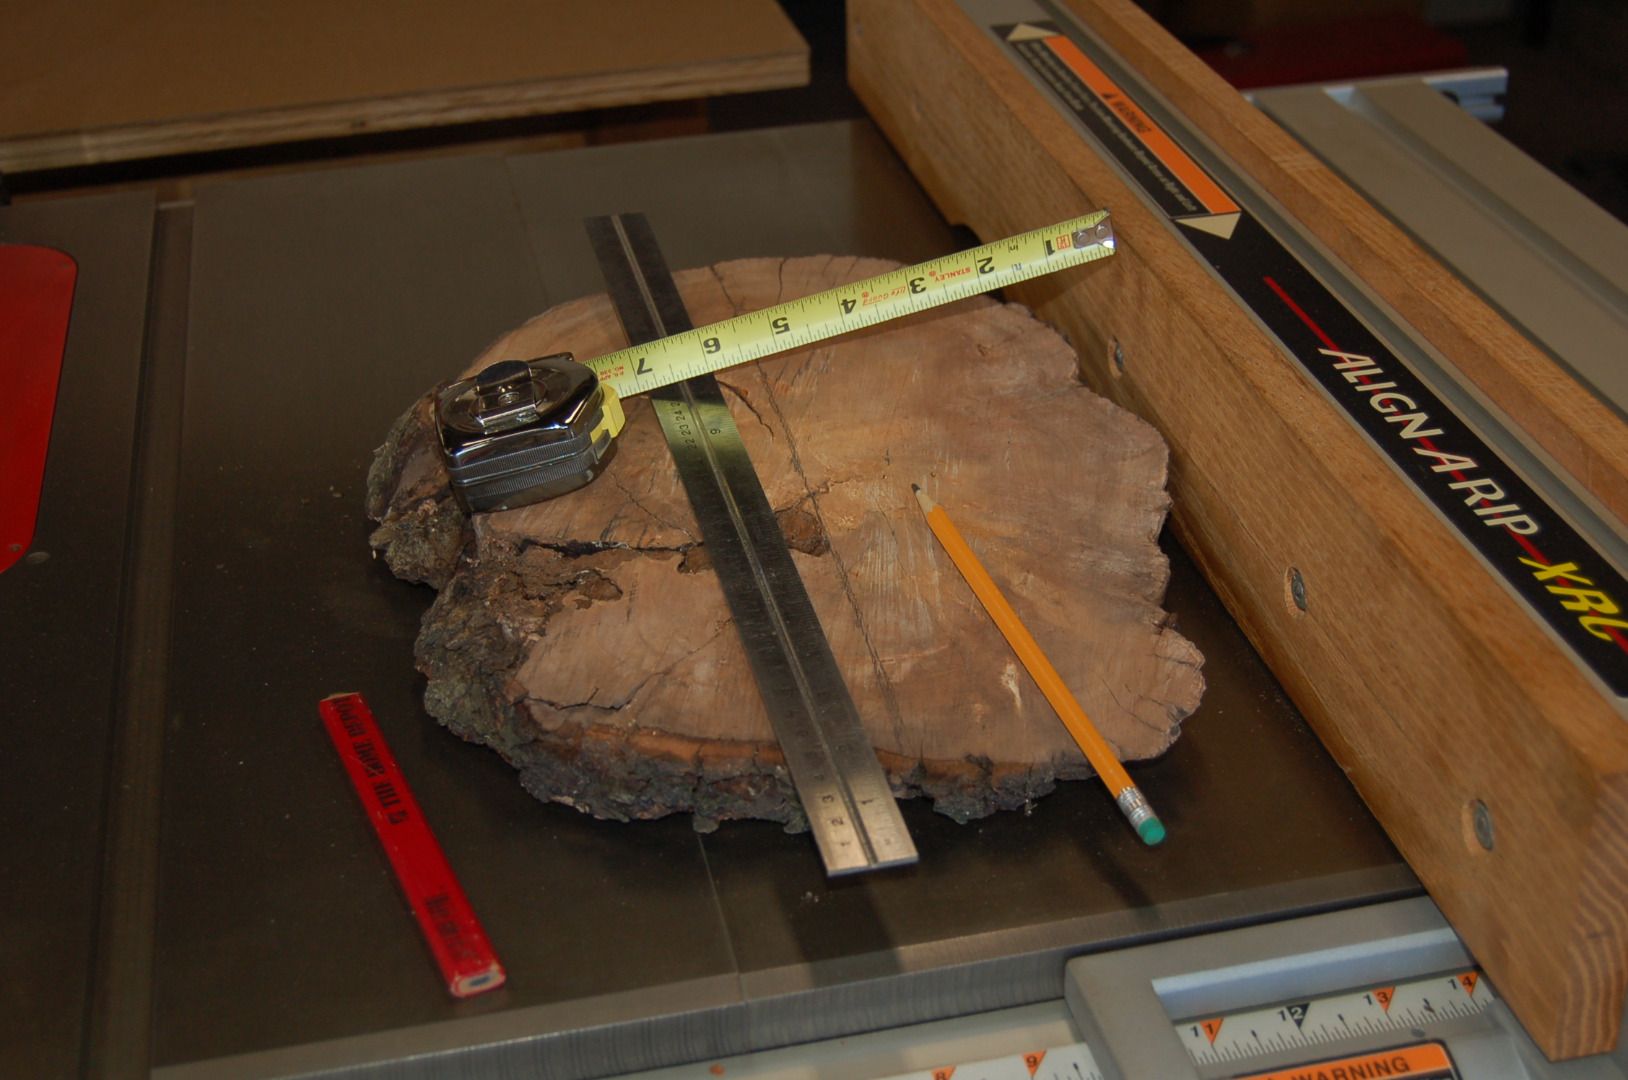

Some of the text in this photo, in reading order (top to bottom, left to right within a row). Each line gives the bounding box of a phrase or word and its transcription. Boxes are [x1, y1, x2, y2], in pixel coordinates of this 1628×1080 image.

[934, 266, 971, 282] STANLEY
[978, 256, 995, 275] 2
[910, 277, 927, 294] 3
[841, 298, 857, 315] 4
[772, 316, 791, 335] 5
[702, 337, 721, 354] 6
[636, 357, 653, 375] 7
[674, 410, 686, 422] 24
[679, 424, 692, 436] 23
[1318, 347, 1445, 439] ALIGN
[1412, 446, 1478, 473] A
[1448, 477, 1539, 537] RIP
[822, 795, 834, 803] 3
[1026, 1055, 1038, 1067] 9
